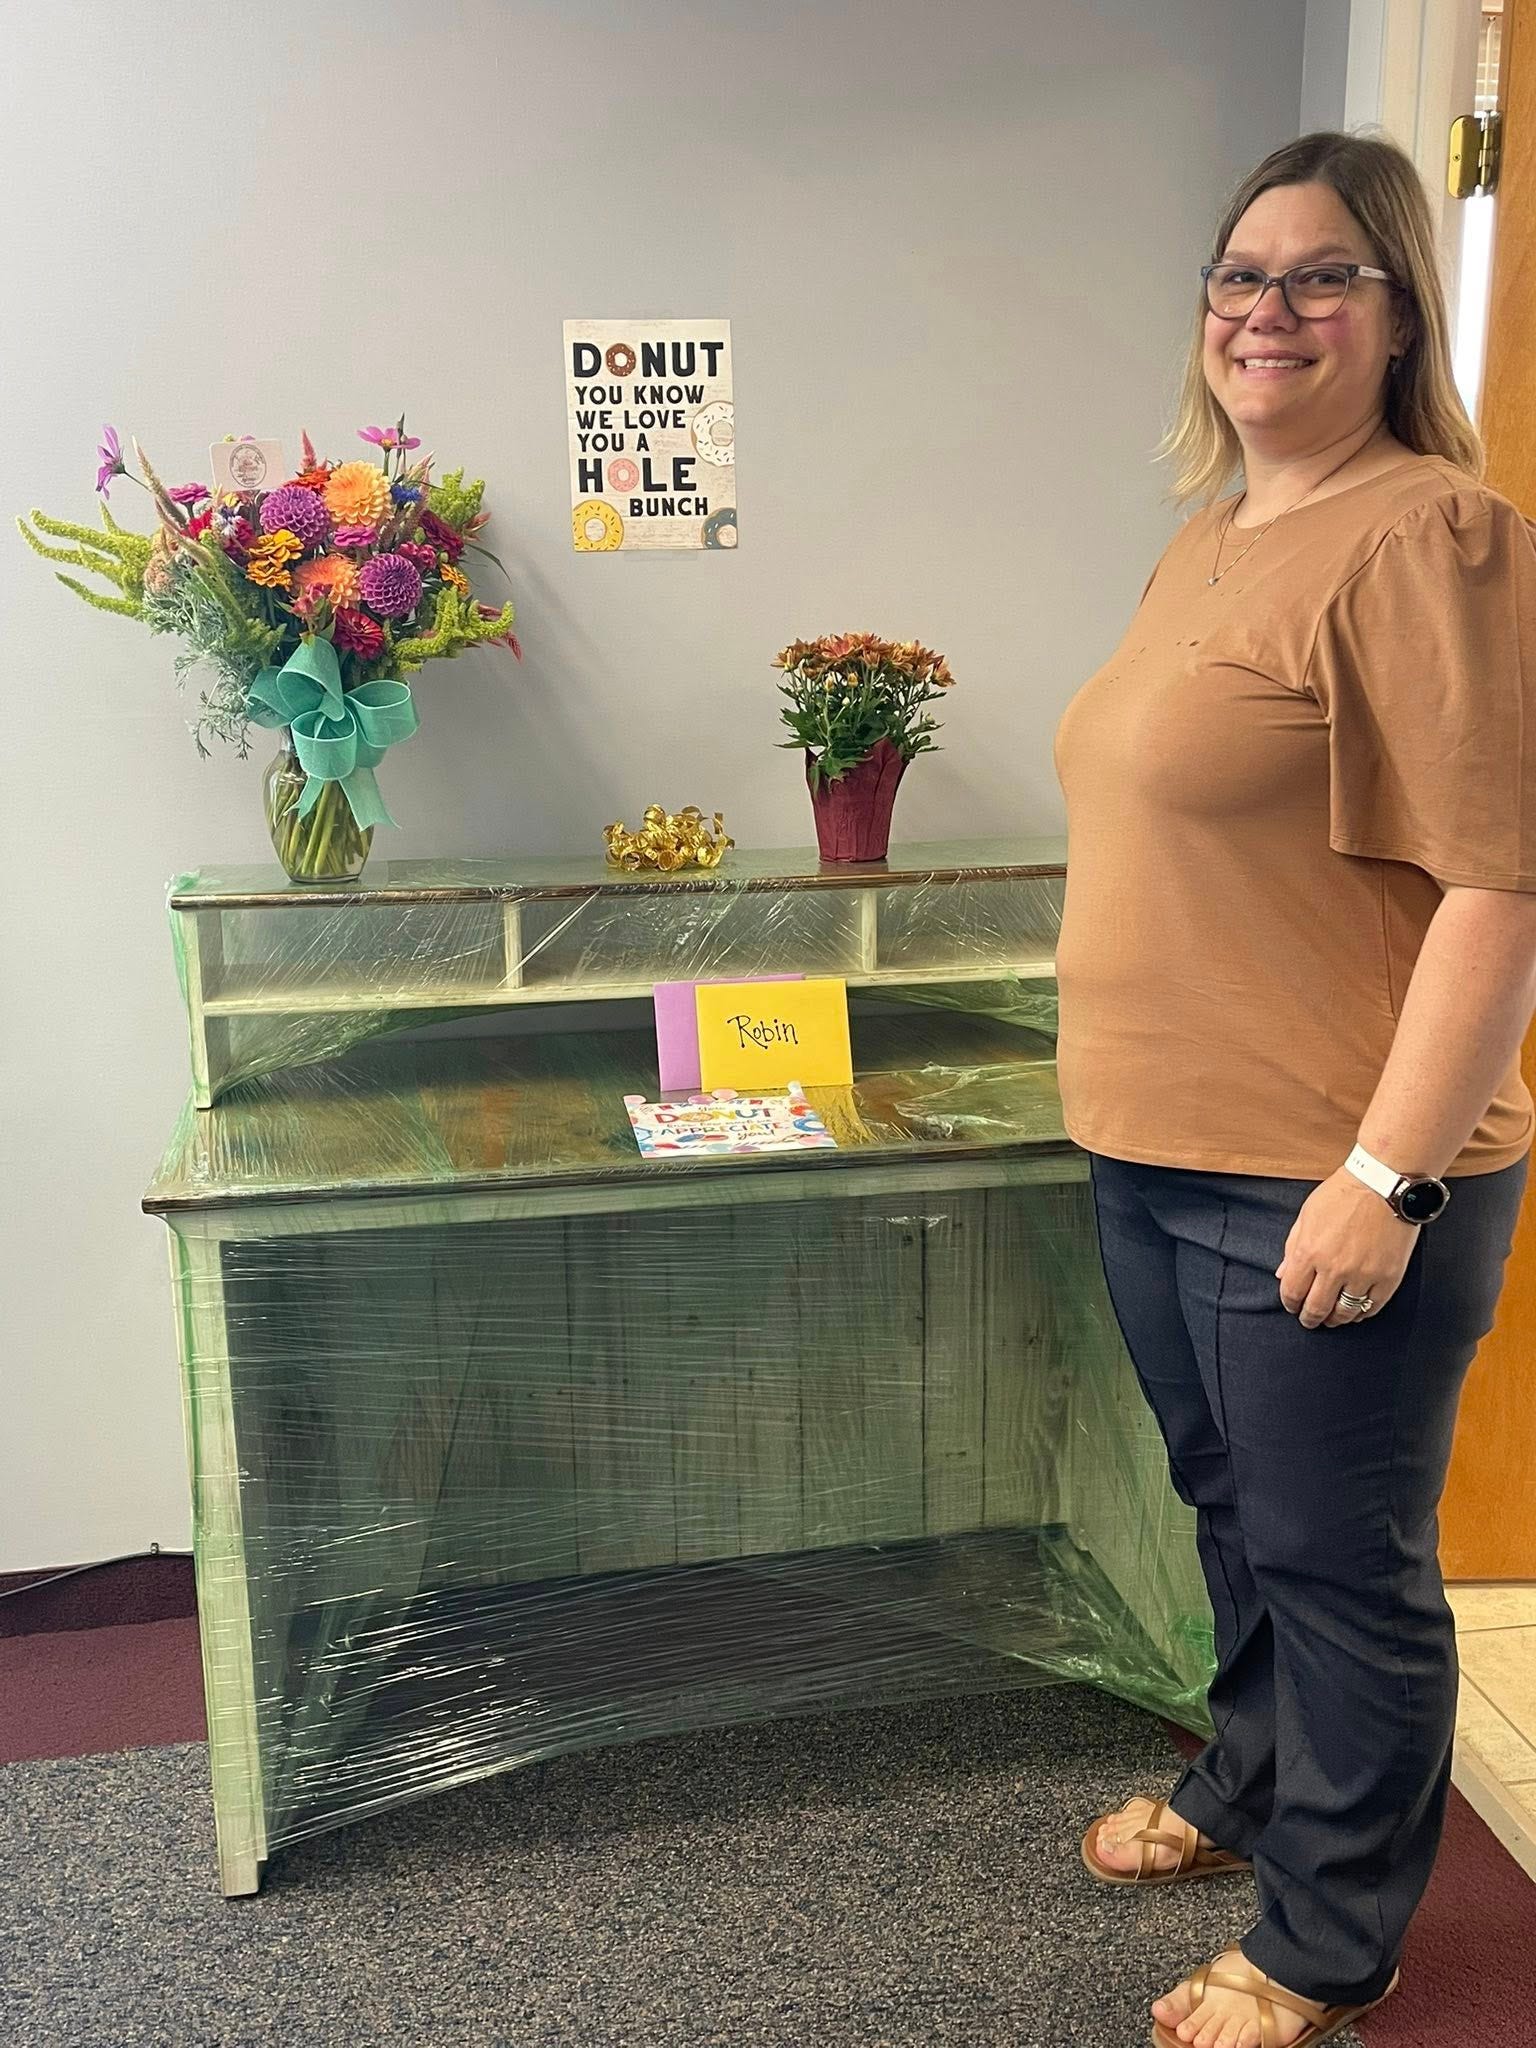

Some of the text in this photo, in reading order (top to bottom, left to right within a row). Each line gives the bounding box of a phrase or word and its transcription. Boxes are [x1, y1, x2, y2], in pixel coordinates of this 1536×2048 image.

[573, 342, 724, 377] DONUT
[575, 385, 704, 405] YOU KNOW
[576, 410, 686, 429] WE LOVE
[577, 433, 650, 452] YOU A
[578, 457, 697, 492] HOLE
[629, 497, 708, 516] BUNCH
[727, 1014, 798, 1049] Robin
[655, 1107, 775, 1124] DONUT
[660, 1122, 782, 1135] APPRECIATE
